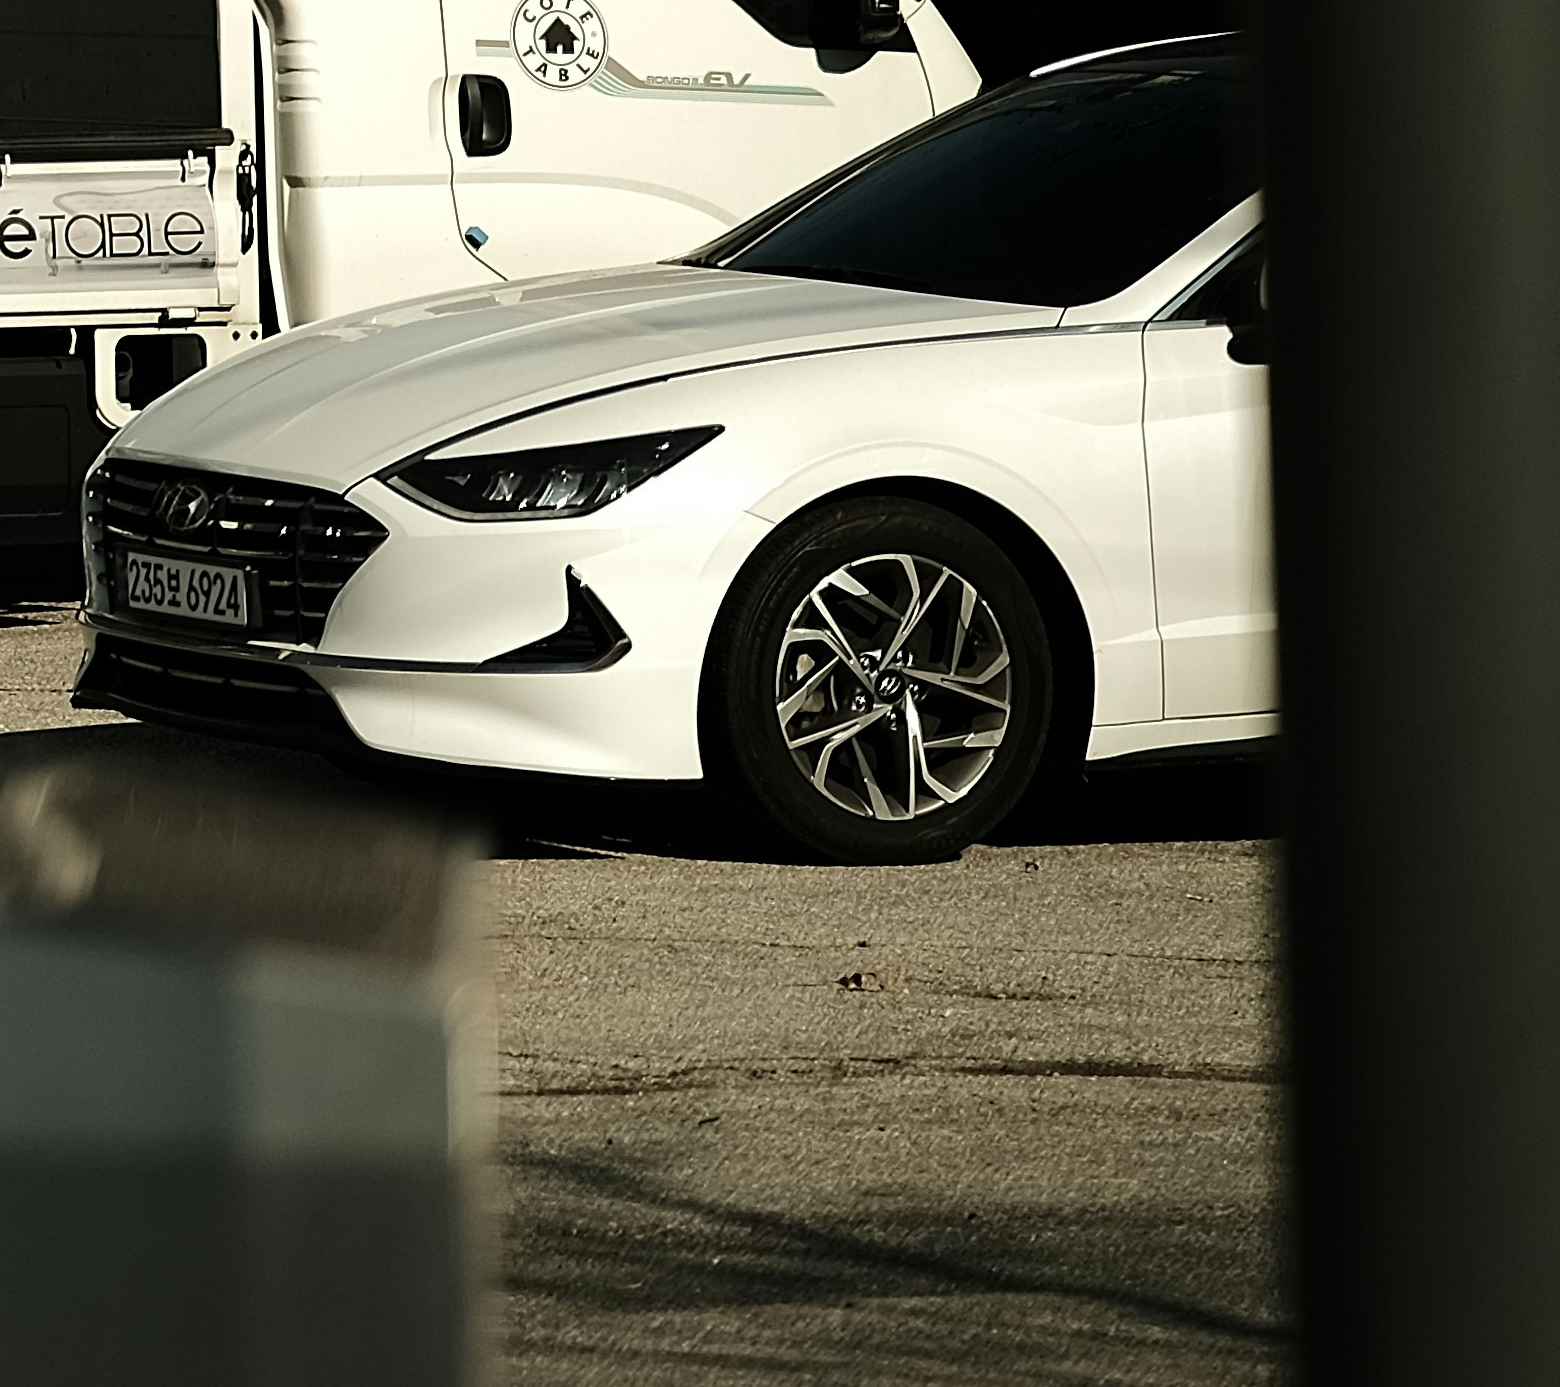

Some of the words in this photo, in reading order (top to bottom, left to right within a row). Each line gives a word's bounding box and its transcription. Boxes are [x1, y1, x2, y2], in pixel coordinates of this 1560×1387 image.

[522, 45, 600, 82] TABLE
[703, 71, 752, 88] EV
[186, 567, 241, 619] 6924
